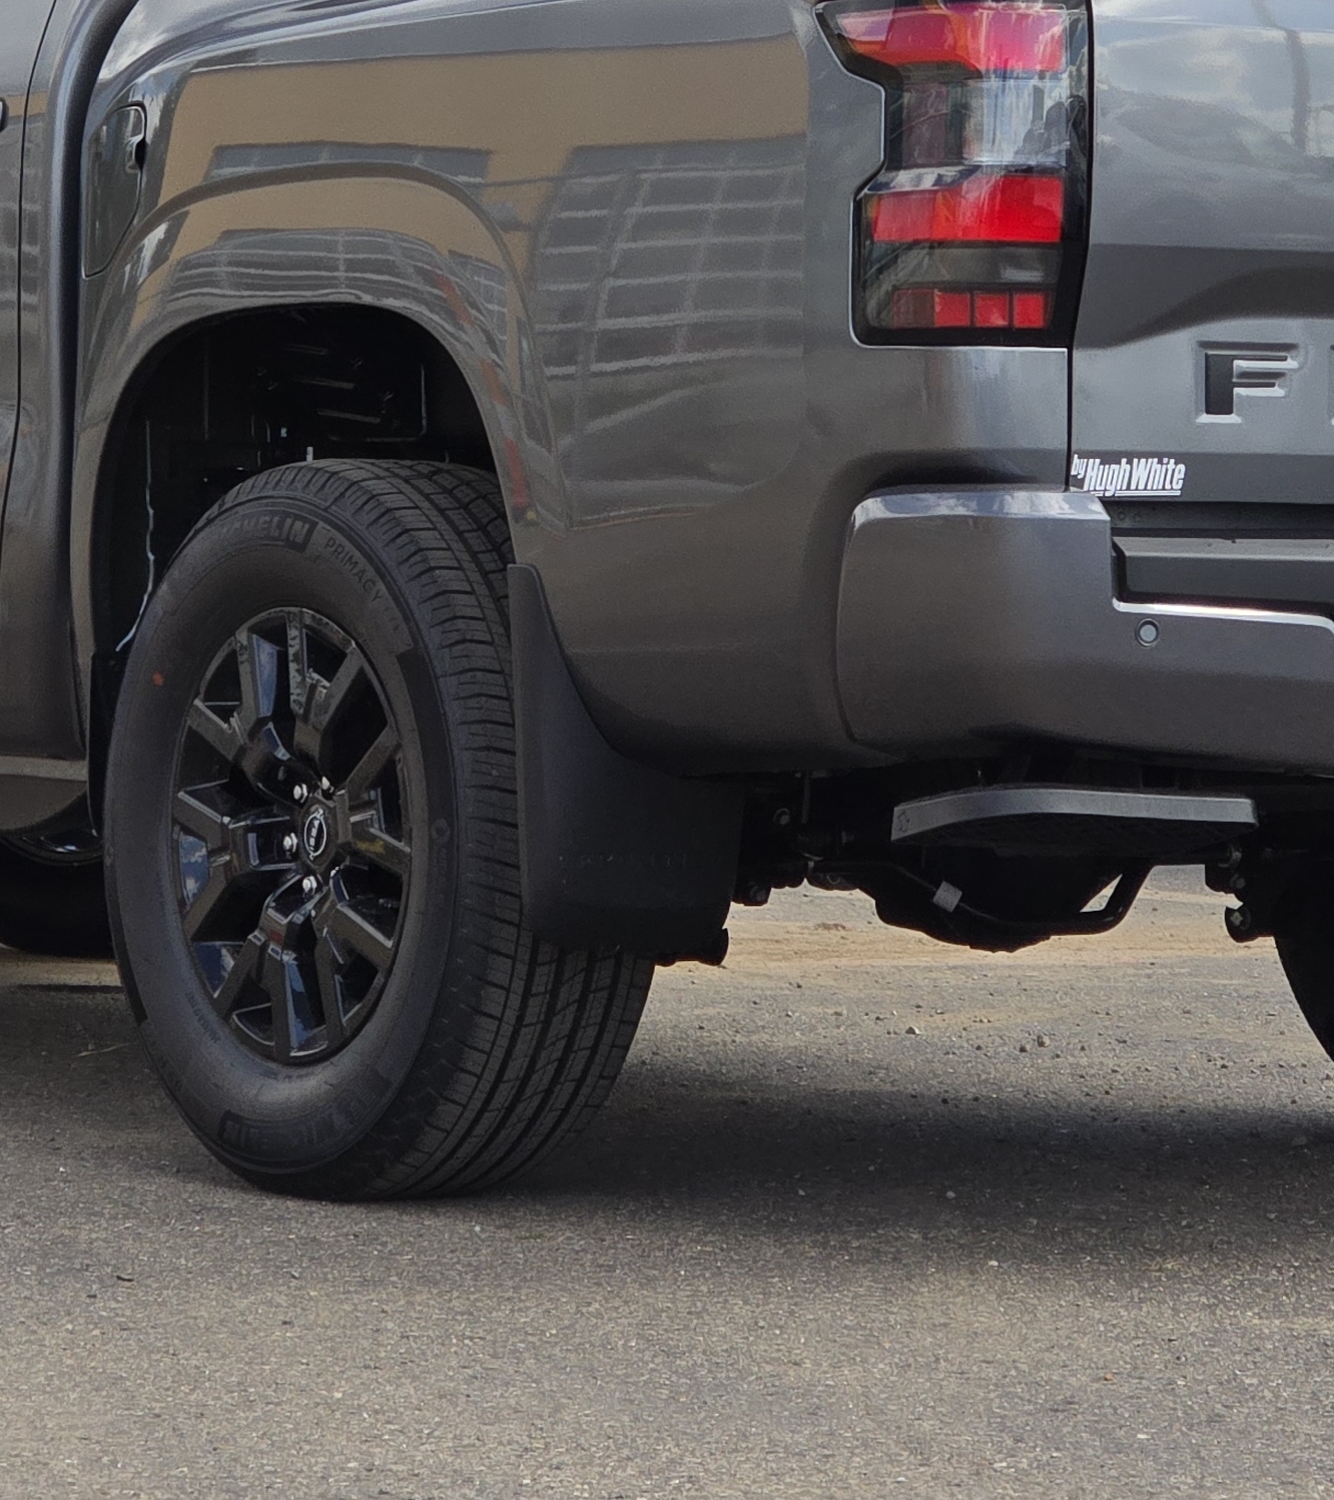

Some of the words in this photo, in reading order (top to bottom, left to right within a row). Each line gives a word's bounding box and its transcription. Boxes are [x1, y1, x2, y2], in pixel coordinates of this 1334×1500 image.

[1070, 454, 1088, 479] by
[1083, 457, 1131, 497] Hugh
[1130, 457, 1186, 491] White
[324, 536, 384, 602] PRIMACY
